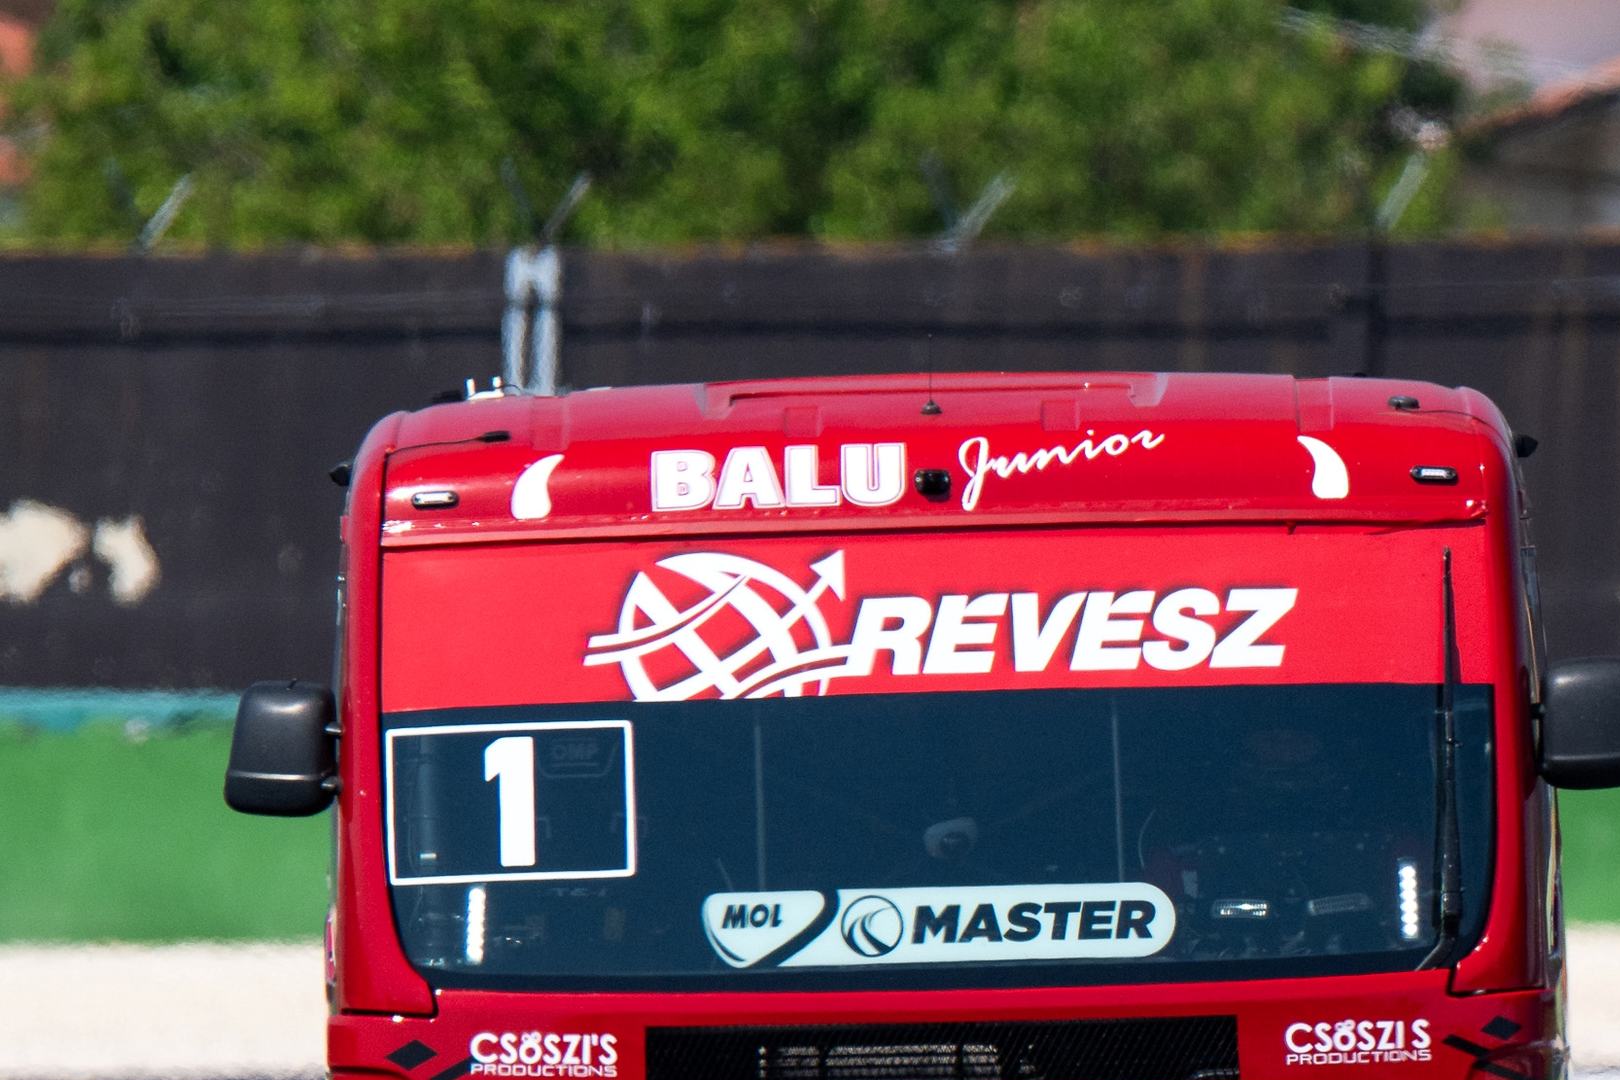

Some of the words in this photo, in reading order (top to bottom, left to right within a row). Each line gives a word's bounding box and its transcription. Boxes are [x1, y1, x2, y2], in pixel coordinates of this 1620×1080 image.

[651, 442, 908, 512] BALU
[957, 428, 1166, 511] Junior
[484, 736, 536, 867] 1
[720, 903, 784, 930] MOL
[911, 900, 1157, 945] MASTER
[470, 1063, 618, 1077] PRODUCTIONS
[1286, 1049, 1432, 1066] PRODUCTIONS
